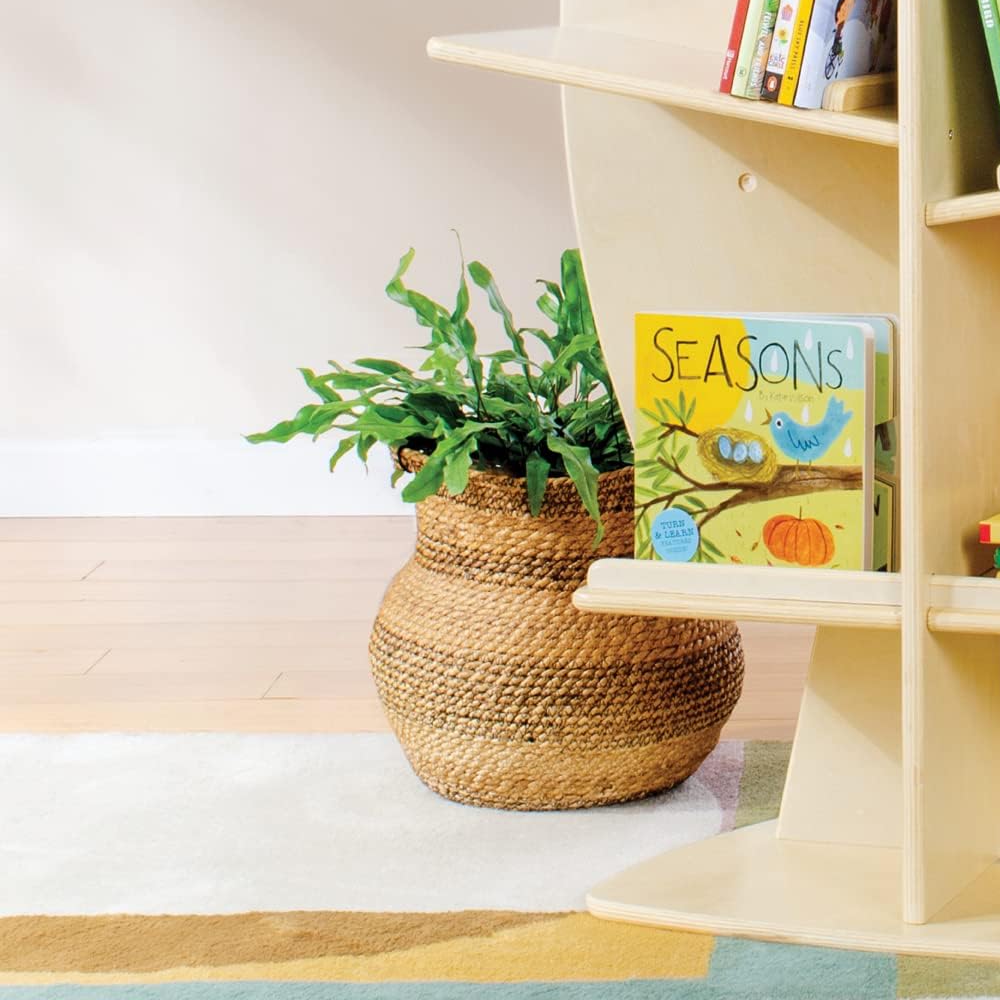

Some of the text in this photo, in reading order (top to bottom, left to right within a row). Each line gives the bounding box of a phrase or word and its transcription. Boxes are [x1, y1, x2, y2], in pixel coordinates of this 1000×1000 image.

[651, 326, 843, 394] SEASONS
[660, 520, 685, 529] TURN
[665, 528, 694, 538] LEARN
